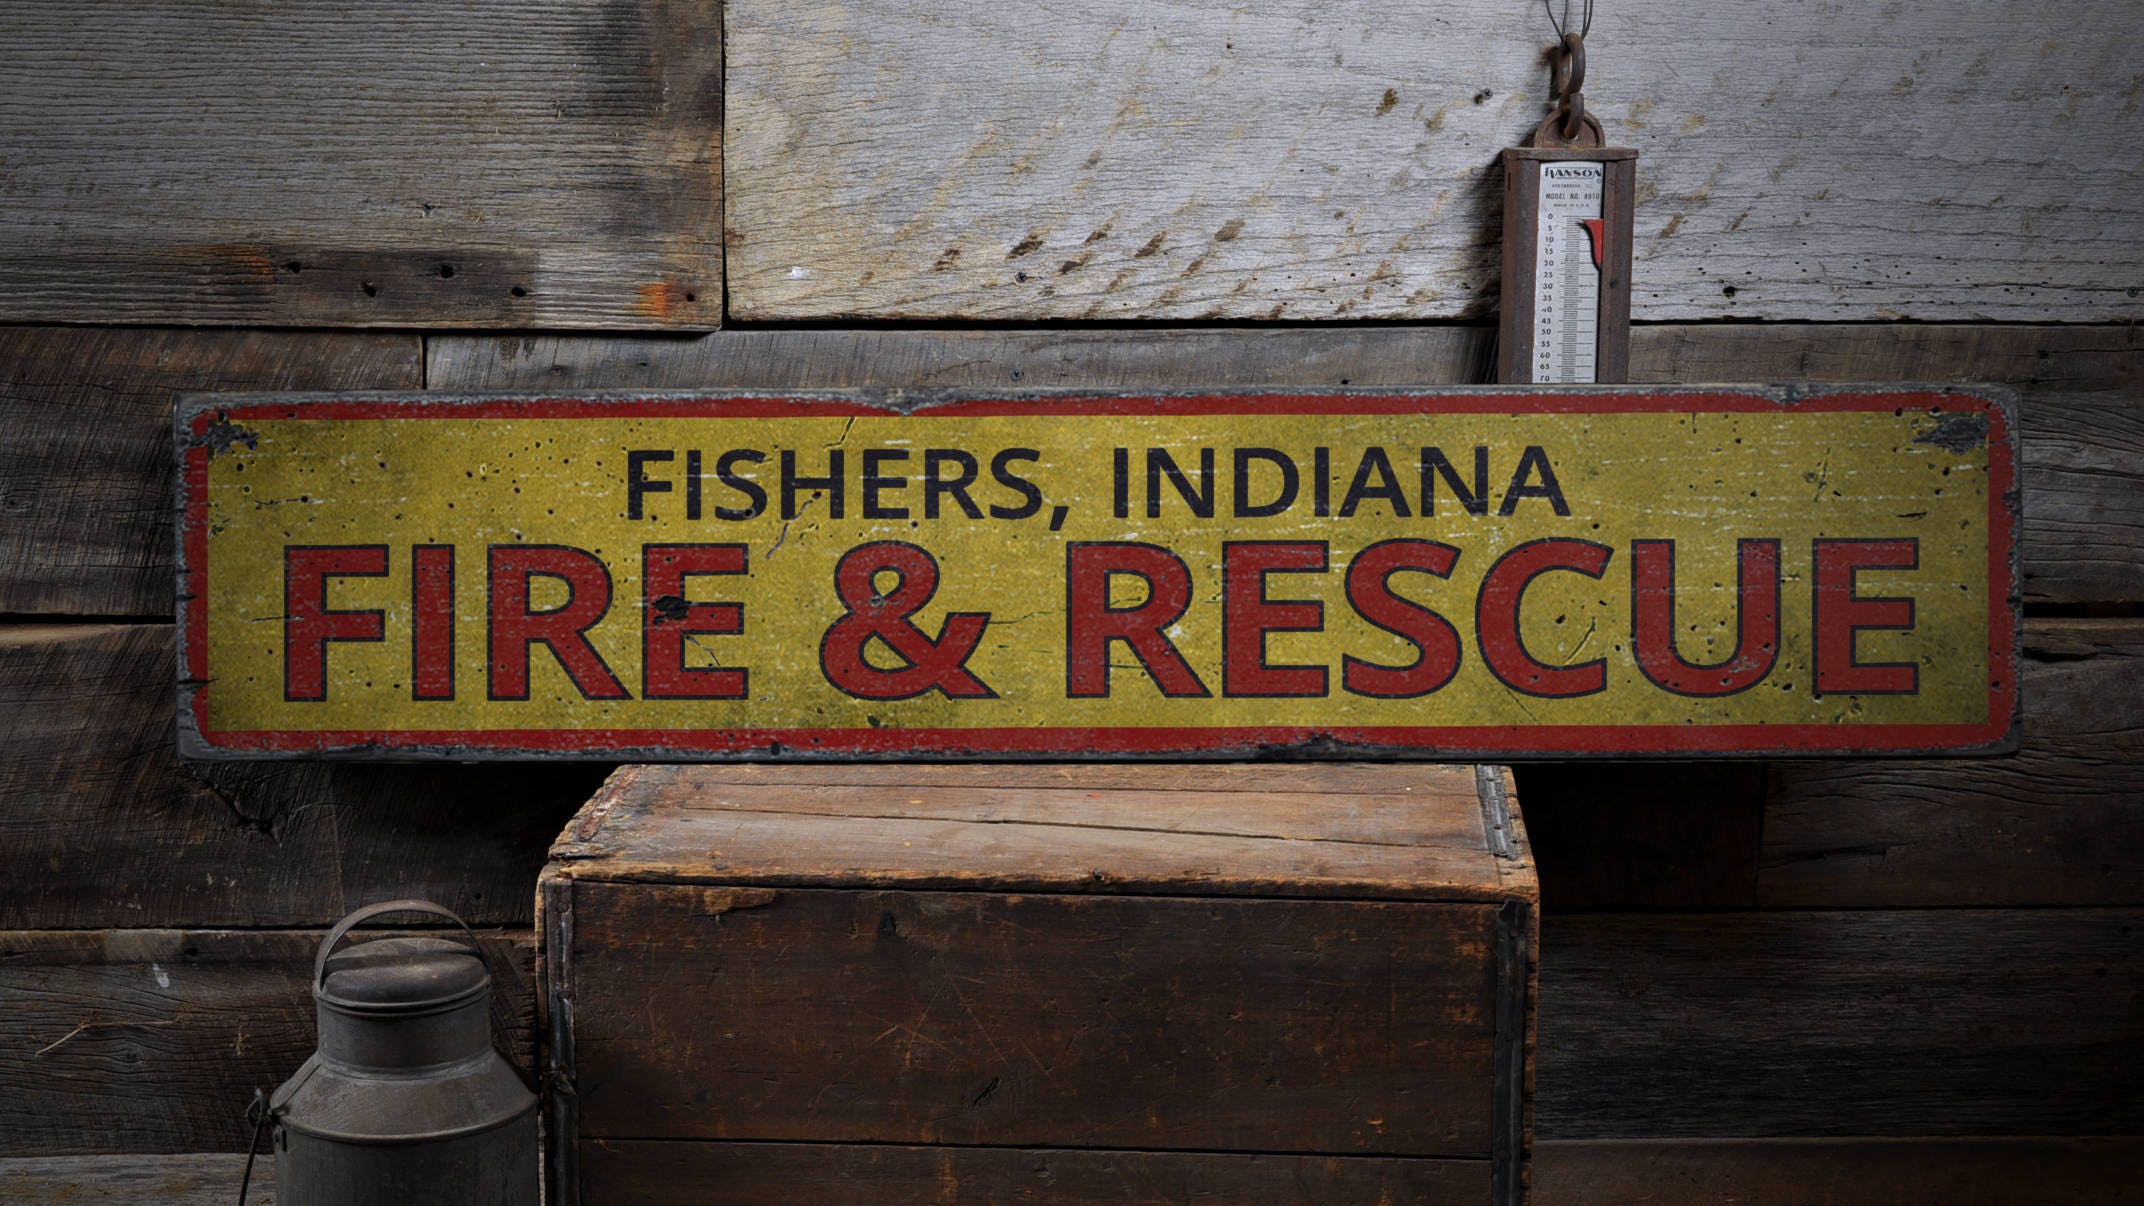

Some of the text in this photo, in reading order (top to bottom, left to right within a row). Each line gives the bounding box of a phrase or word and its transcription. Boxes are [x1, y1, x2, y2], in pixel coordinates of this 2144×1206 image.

[1545, 167, 1602, 179] HANSON
[626, 446, 1572, 532] FISHERS, INDIANA
[283, 537, 1921, 702] FIRE & RESCUE
